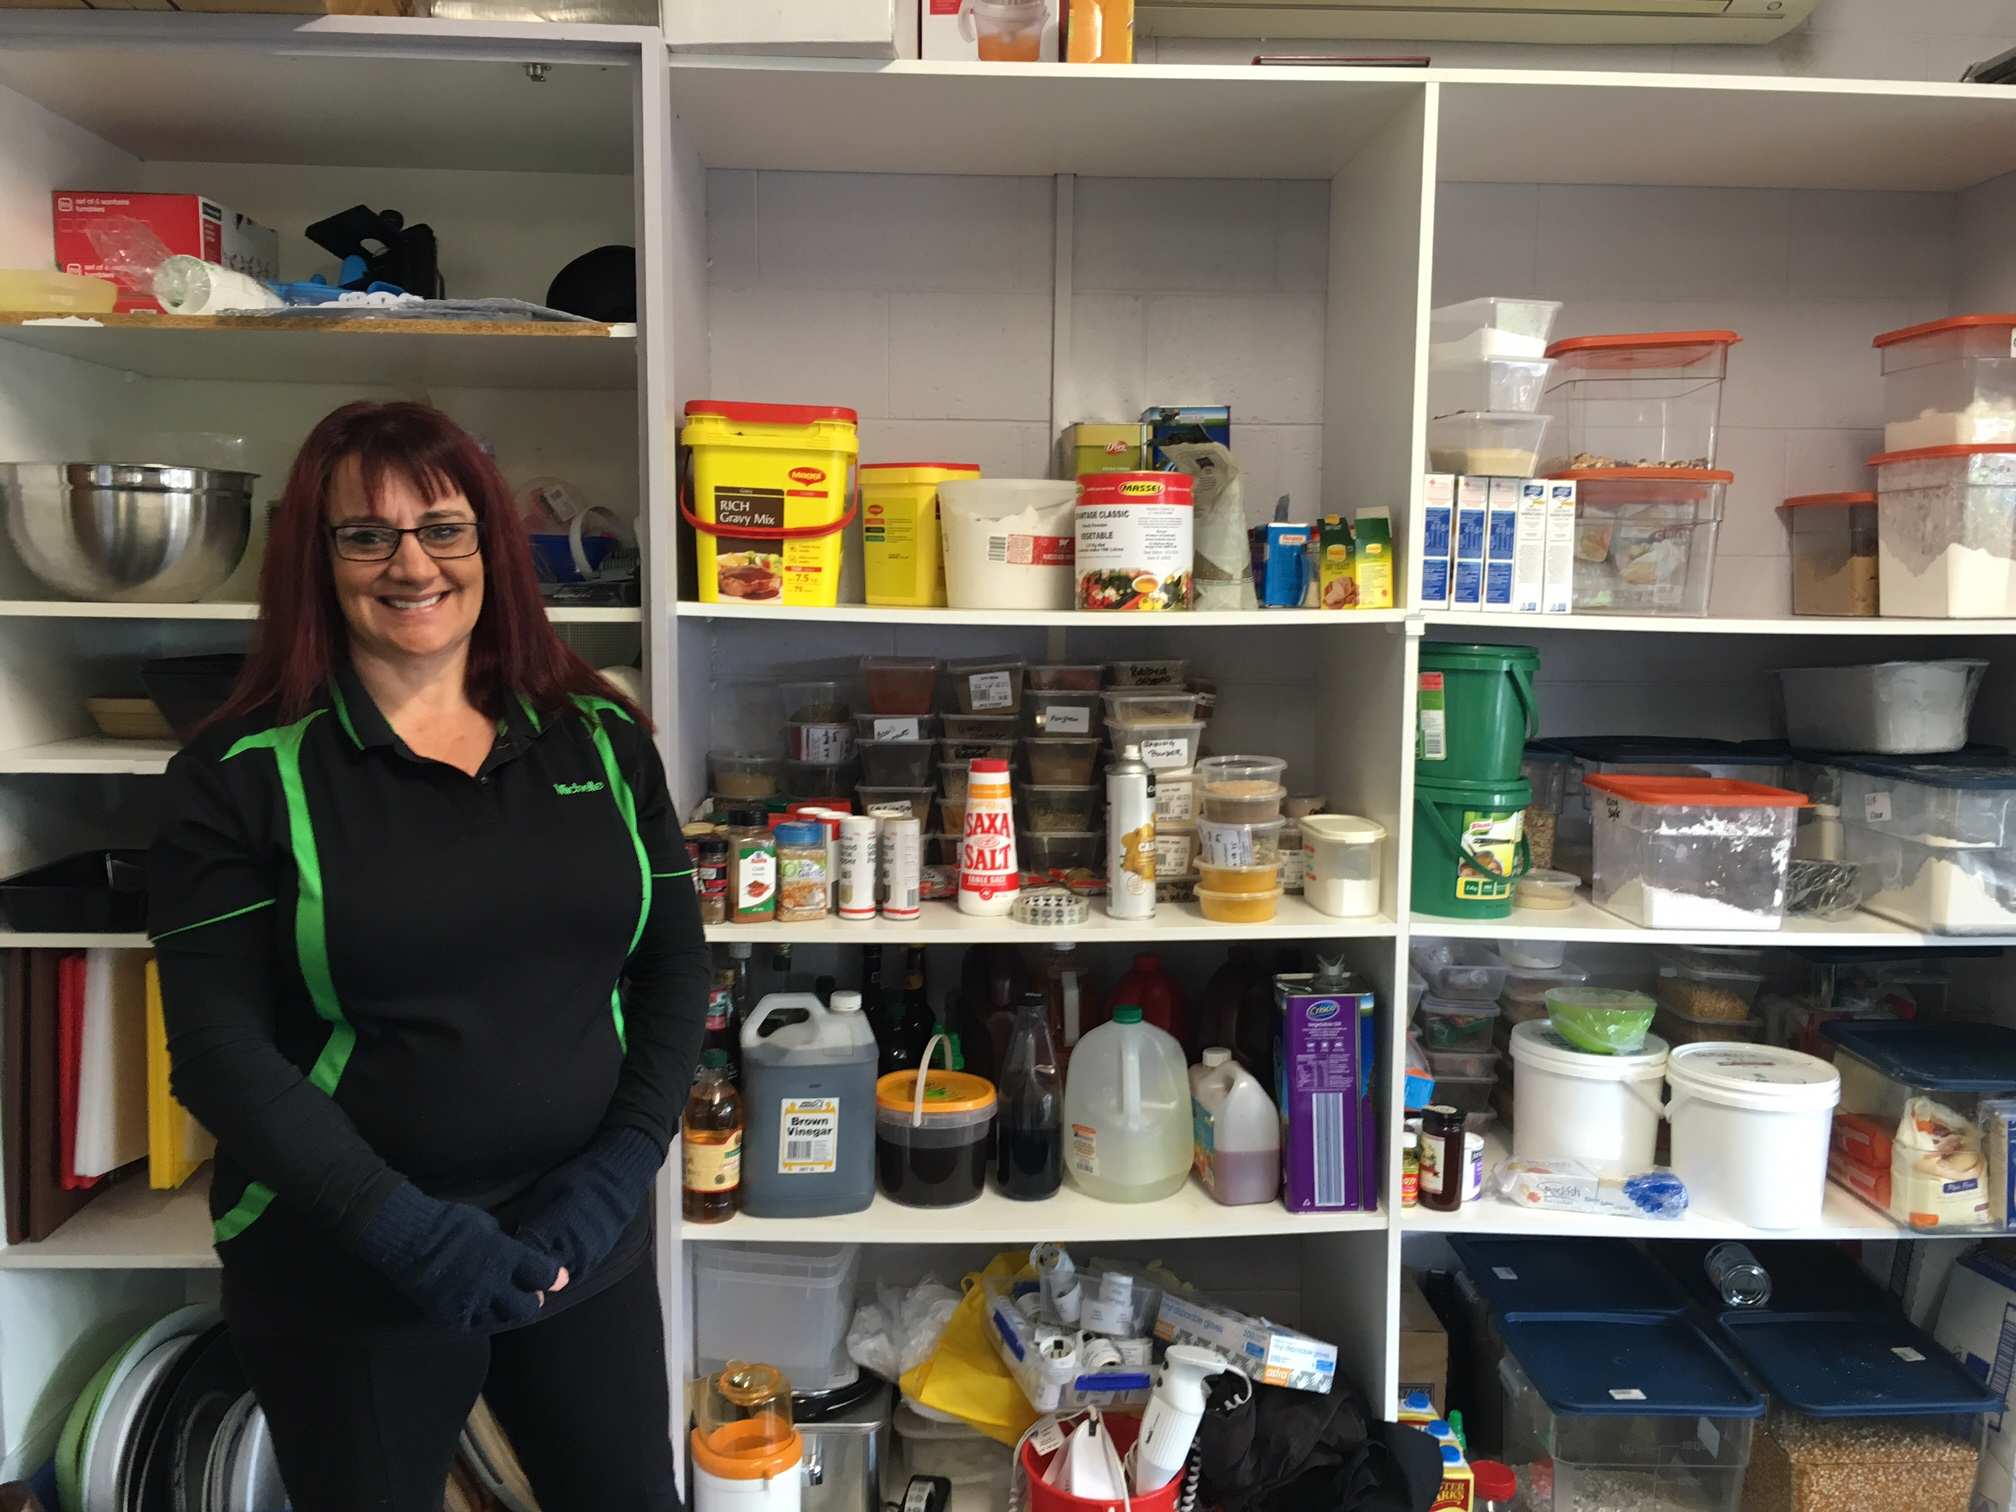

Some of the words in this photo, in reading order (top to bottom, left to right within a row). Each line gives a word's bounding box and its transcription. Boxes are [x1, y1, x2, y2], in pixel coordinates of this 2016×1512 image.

[720, 500, 750, 512] RICH
[719, 511, 751, 526] Gravy
[753, 512, 775, 525] Mix
[964, 811, 1012, 838] SAXA
[964, 843, 1012, 871] SALT
[791, 1117, 829, 1127] Brown
[787, 1126, 833, 1138] Vinegar
